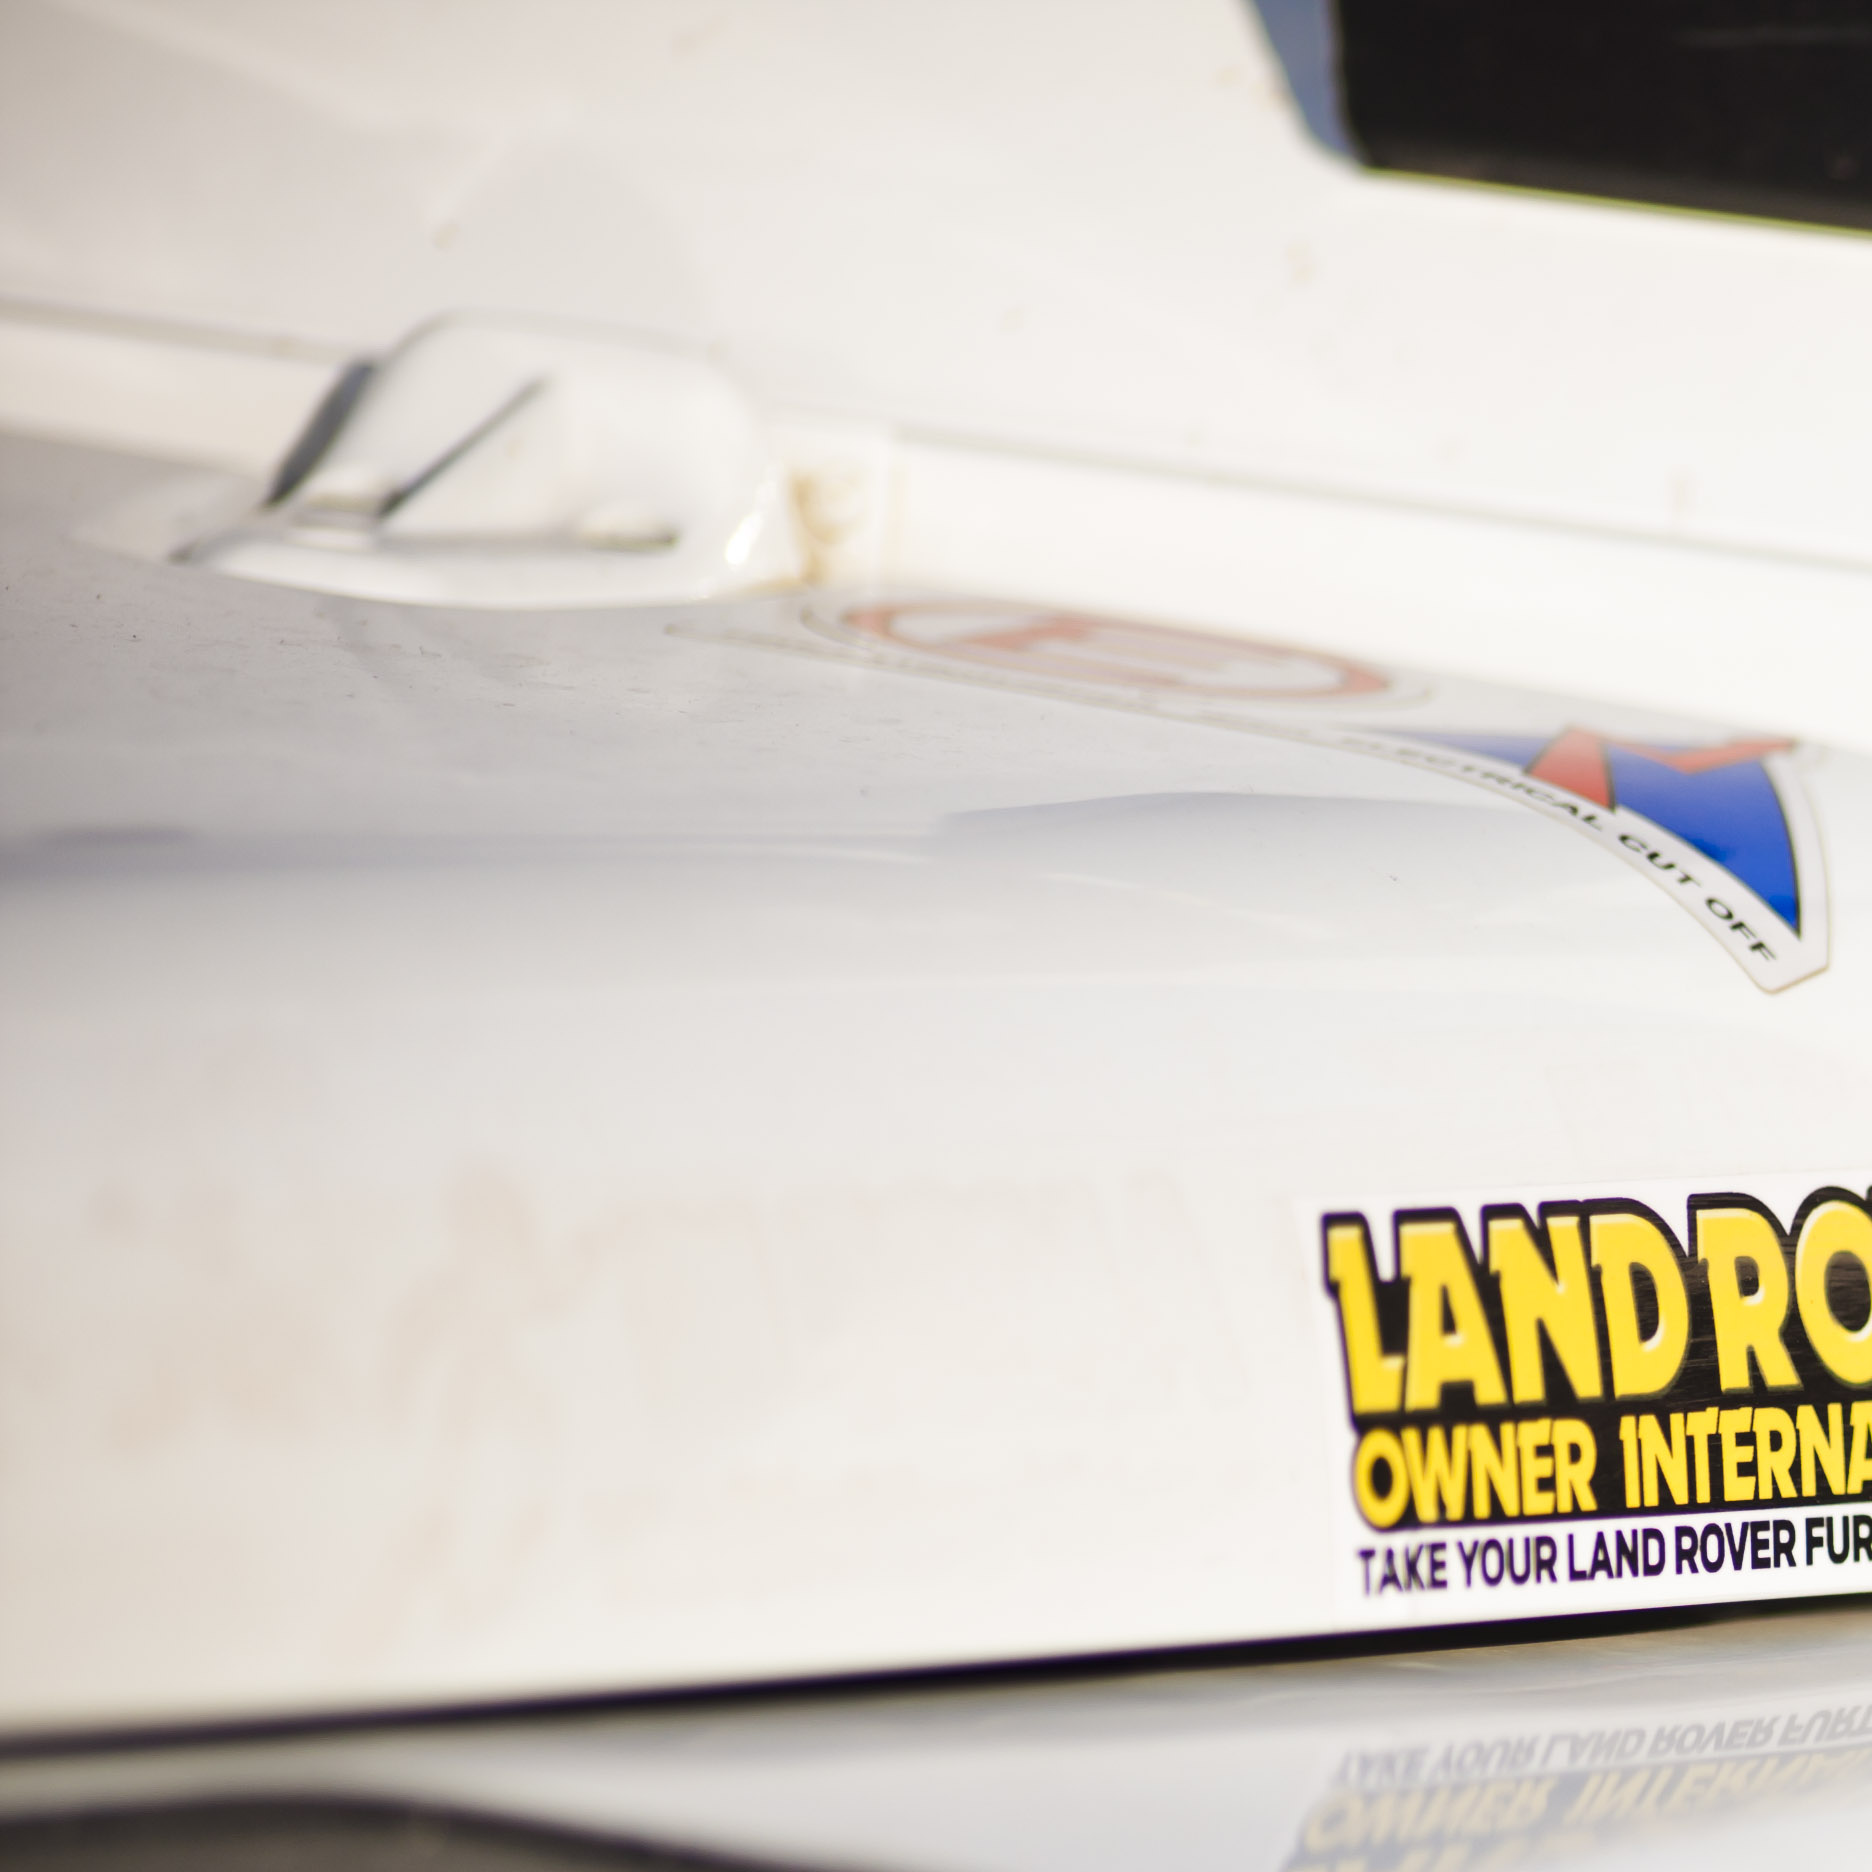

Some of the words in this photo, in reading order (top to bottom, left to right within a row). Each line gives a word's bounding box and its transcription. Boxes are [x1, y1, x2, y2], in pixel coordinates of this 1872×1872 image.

[1617, 832, 1701, 889] CUT
[1704, 895, 1778, 963] OFF
[1325, 1208, 1690, 1414] LAND
[1353, 1416, 1598, 1530] OWNER
[1356, 1540, 1448, 1596] TAKE
[1458, 1534, 1558, 1588] YOUR
[1568, 1527, 1667, 1582] LAND
[1674, 1519, 1797, 1575] ROVER
